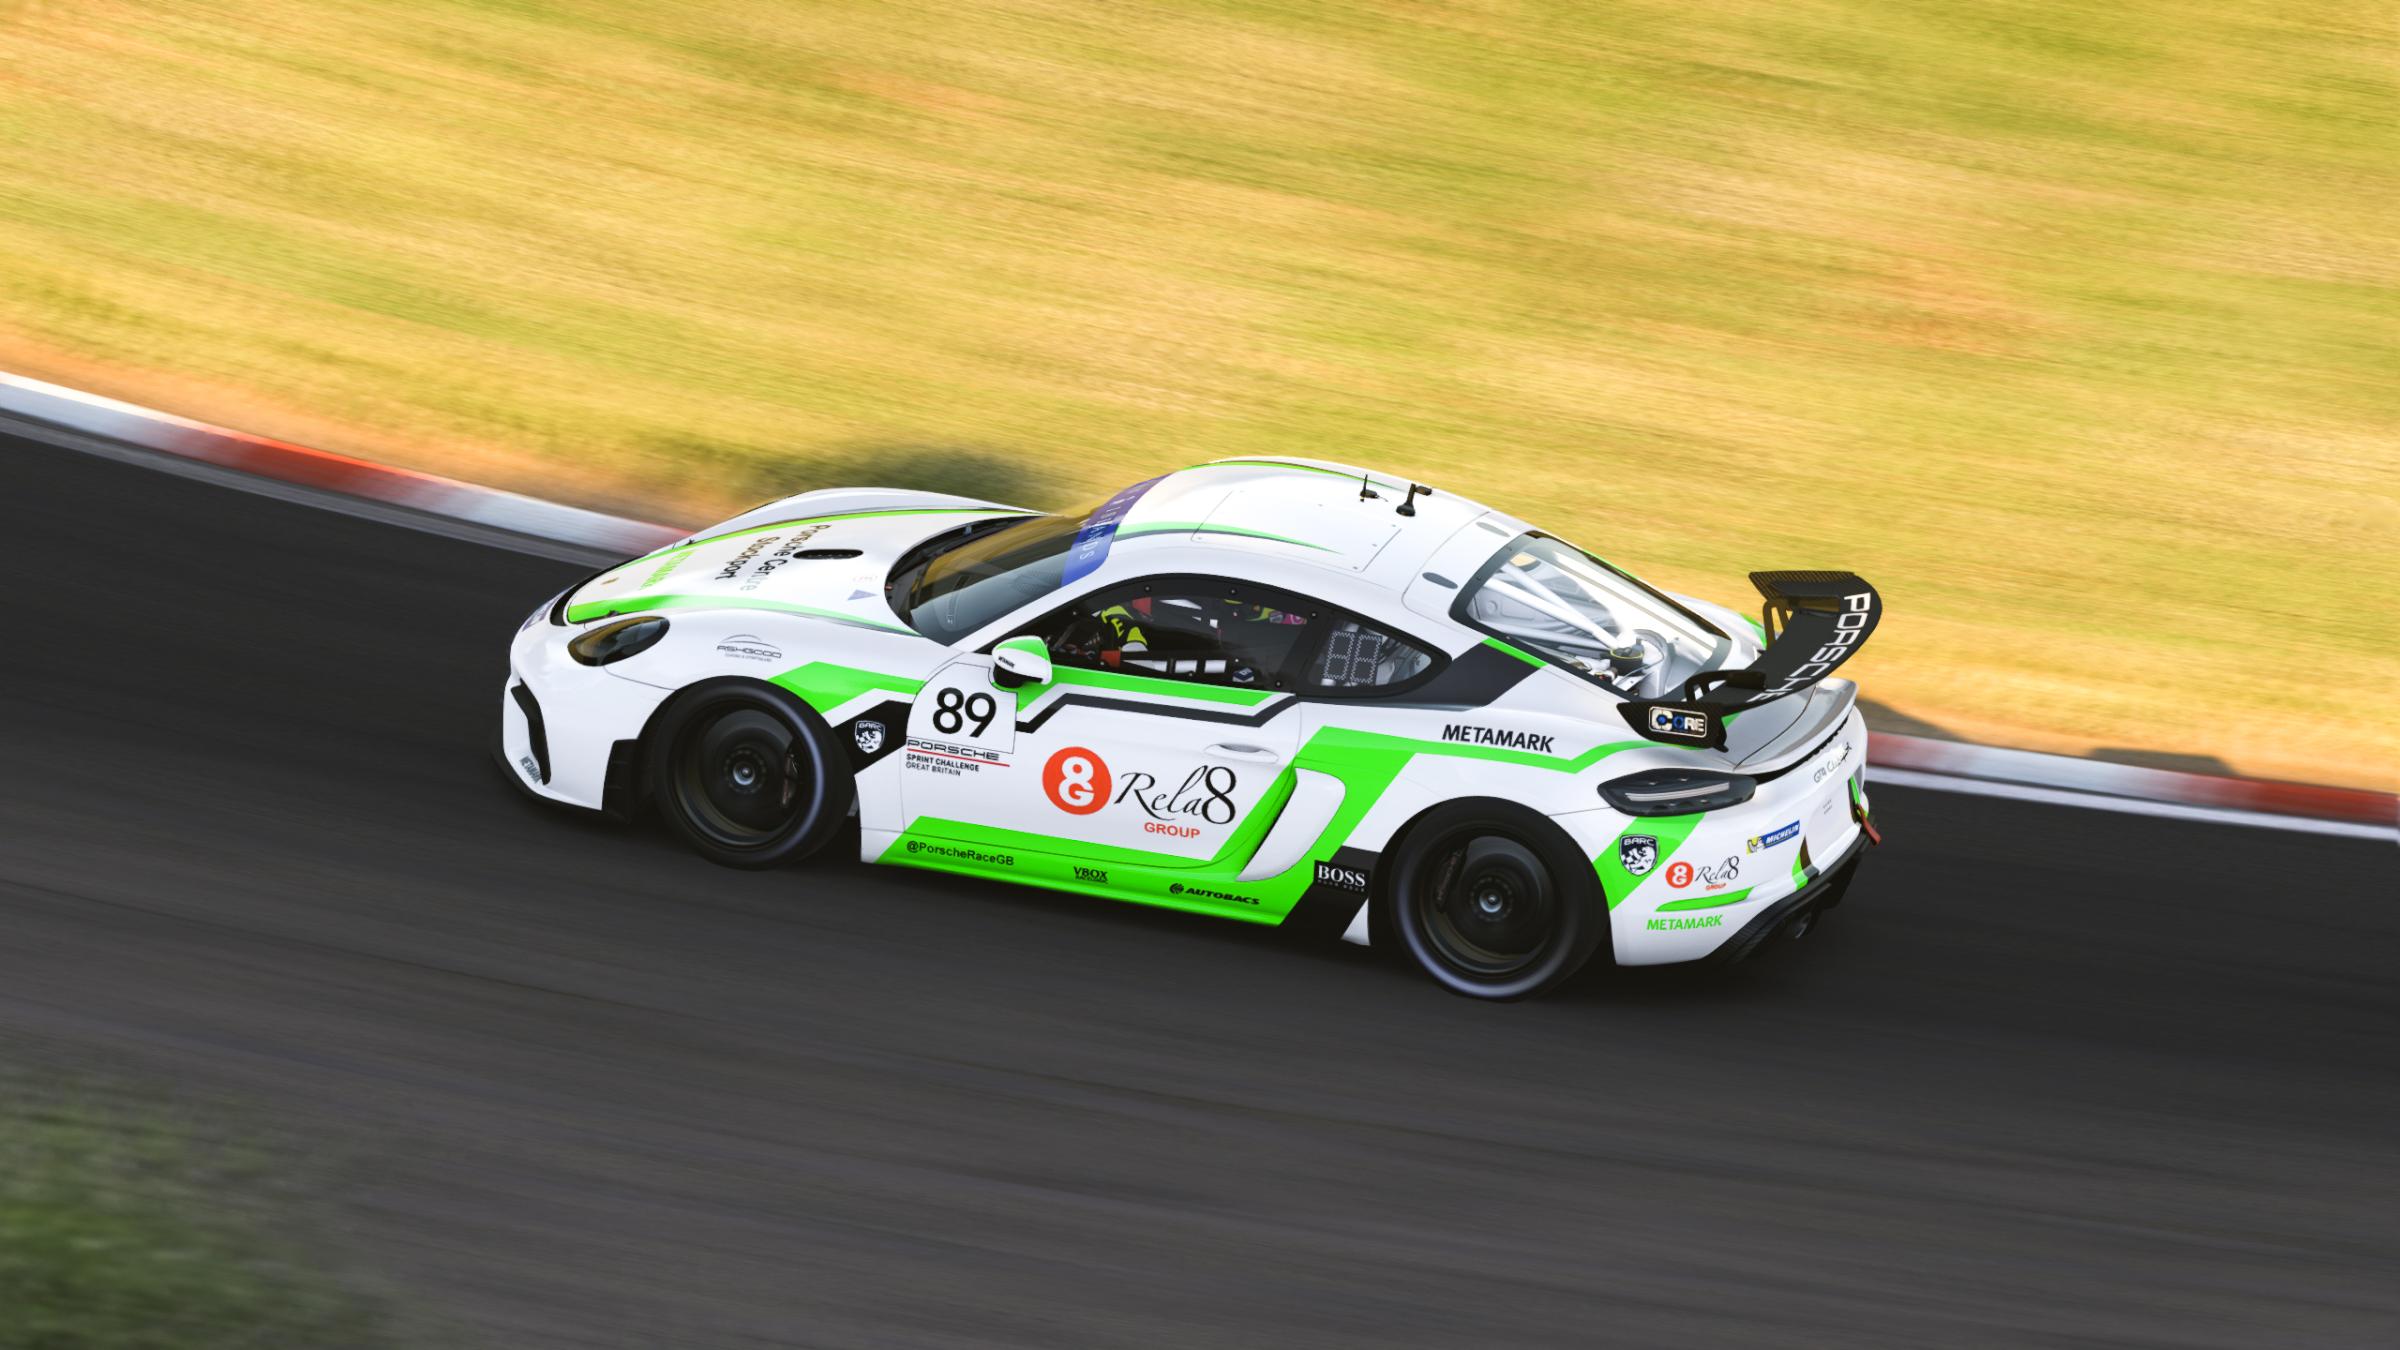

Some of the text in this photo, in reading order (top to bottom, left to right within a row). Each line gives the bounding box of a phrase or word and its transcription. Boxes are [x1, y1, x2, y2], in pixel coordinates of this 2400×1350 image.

[1745, 592, 1871, 703] PORSCHE
[932, 687, 997, 738] 89
[1442, 724, 1554, 753] METAMARK
[907, 739, 1000, 761] PORSCHE
[905, 761, 961, 777] GREAT BRITAIN
[906, 753, 980, 772] SPRINT CHALLENGE
[1113, 765, 1237, 825] Rela8
[1144, 822, 1201, 838] GROUP
[1766, 824, 1800, 844] MICHELIN
[907, 840, 1015, 866] @PorscheRaceGB
[1623, 838, 1655, 847] BARC
[1073, 866, 1108, 881] VBOX
[1317, 864, 1366, 887] BOSS
[1695, 856, 1740, 884] Rela8
[1185, 887, 1261, 905] AUTOBACS
[1647, 914, 1723, 930] METAMARK
